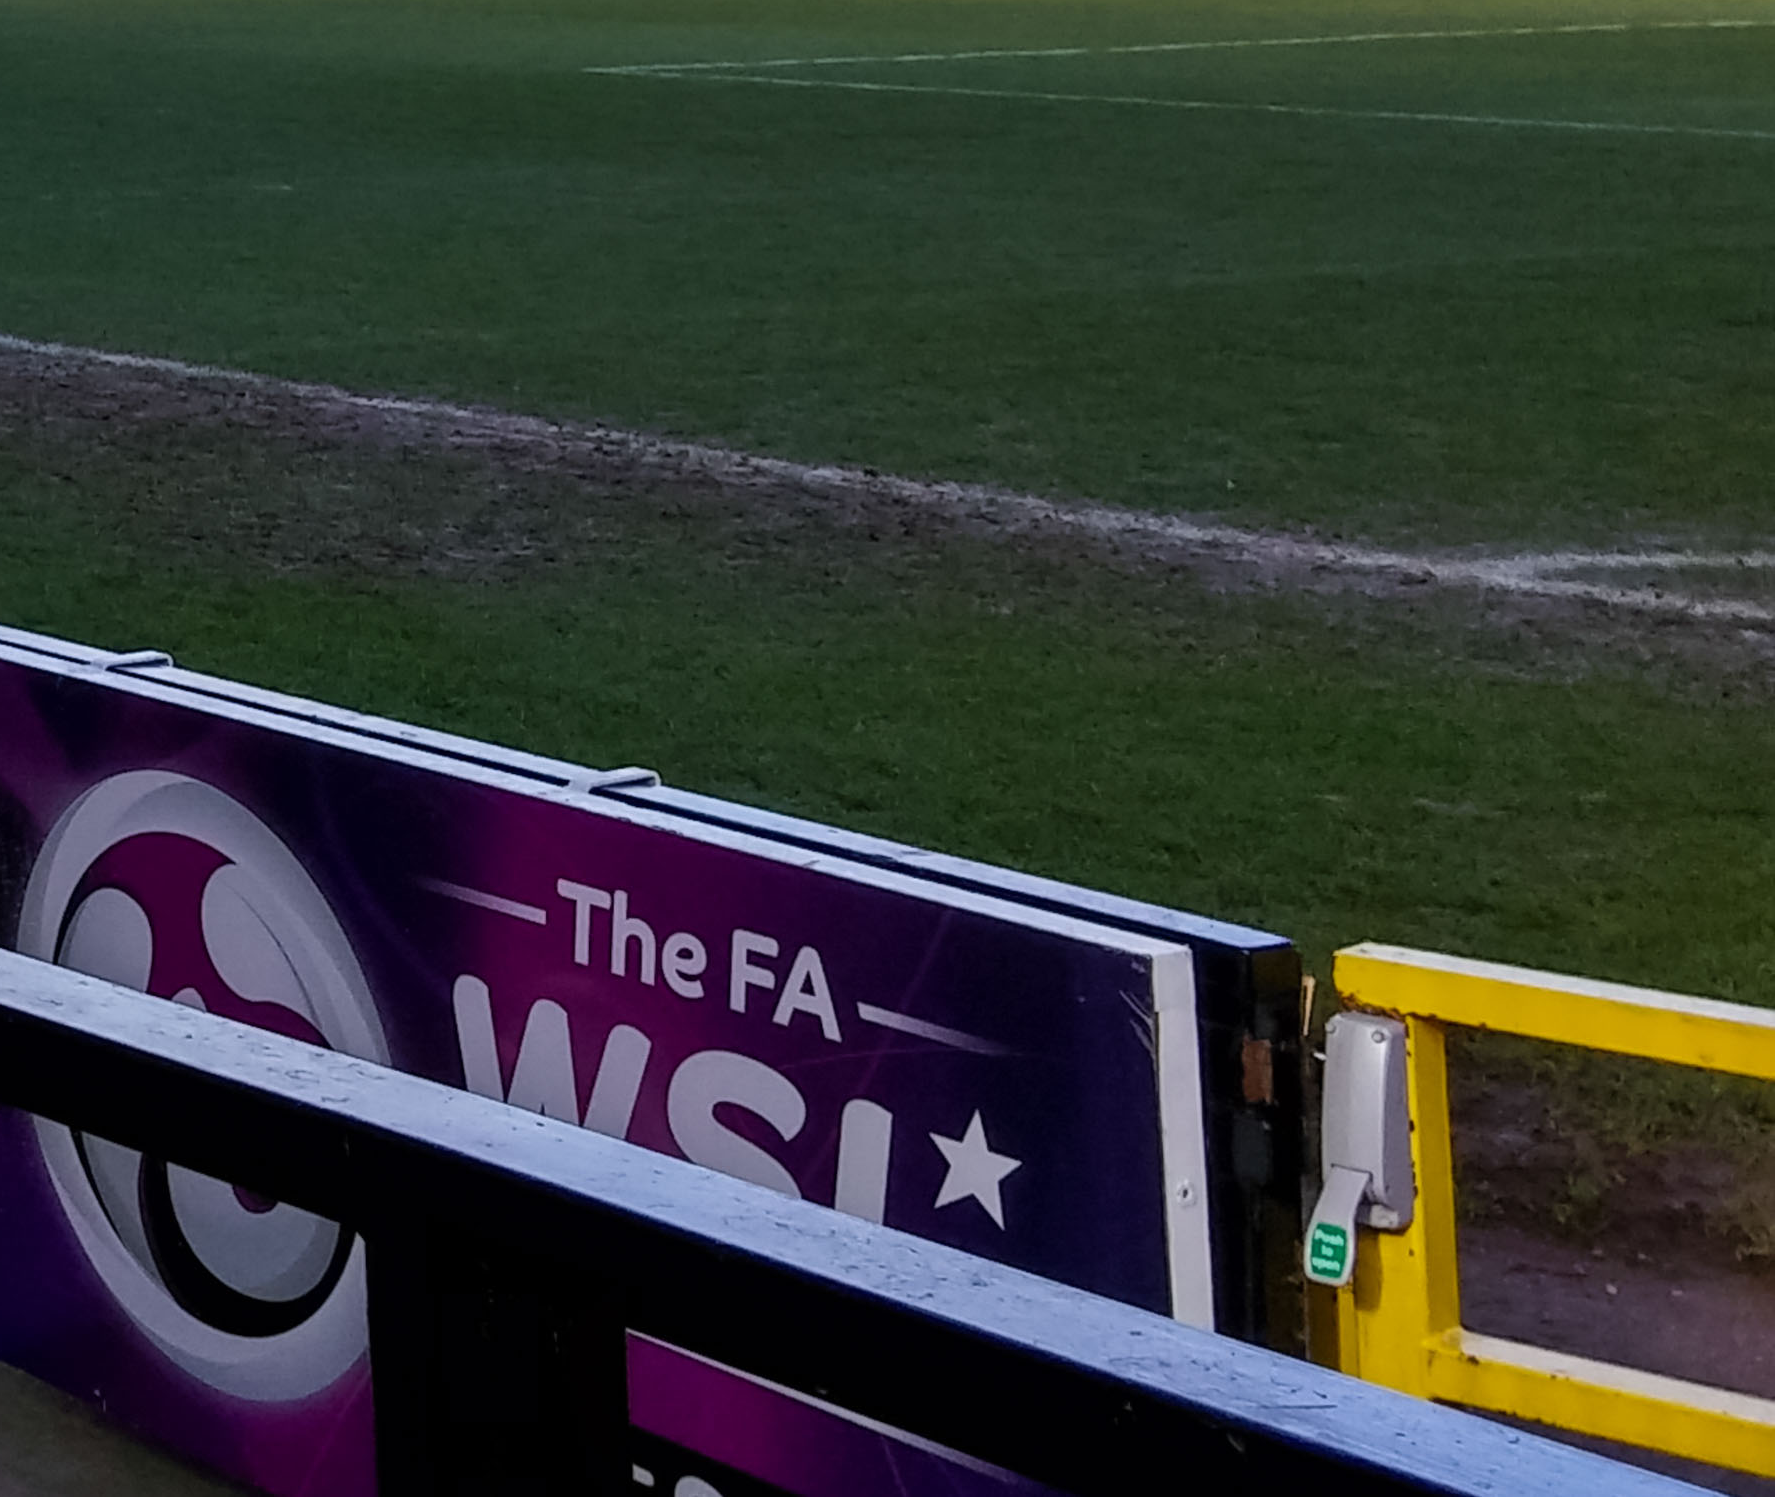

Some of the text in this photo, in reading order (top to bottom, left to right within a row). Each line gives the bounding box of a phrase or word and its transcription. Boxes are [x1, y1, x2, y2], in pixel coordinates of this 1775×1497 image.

[556, 877, 842, 1042] The FA
[1314, 1228, 1344, 1248] Push
[1321, 1245, 1335, 1258] to
[1311, 1256, 1341, 1273] open
